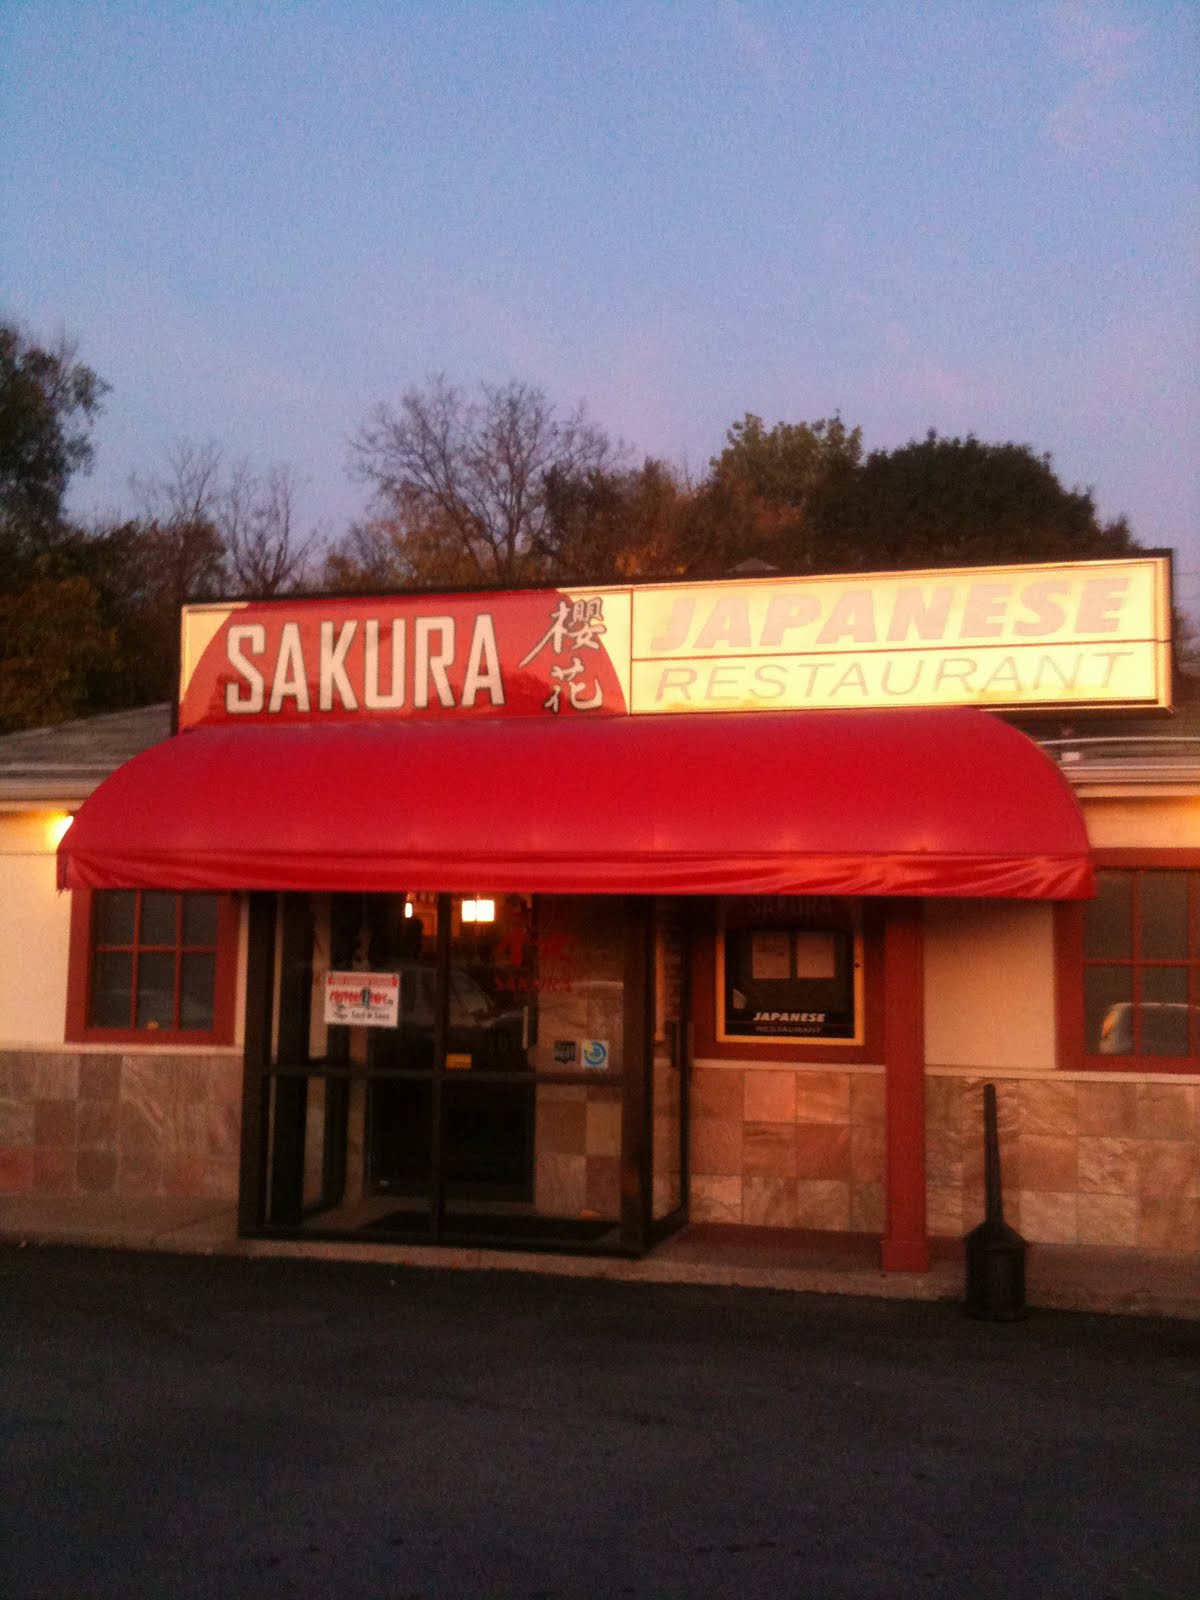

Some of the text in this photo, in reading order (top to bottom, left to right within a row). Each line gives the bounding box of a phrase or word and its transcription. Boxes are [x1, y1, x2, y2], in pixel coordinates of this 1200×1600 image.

[651, 577, 1129, 651] JAPANESE
[226, 614, 505, 713] SAKURA
[654, 651, 1134, 703] RESTAURANT
[753, 1012, 826, 1023] JAPANESE
